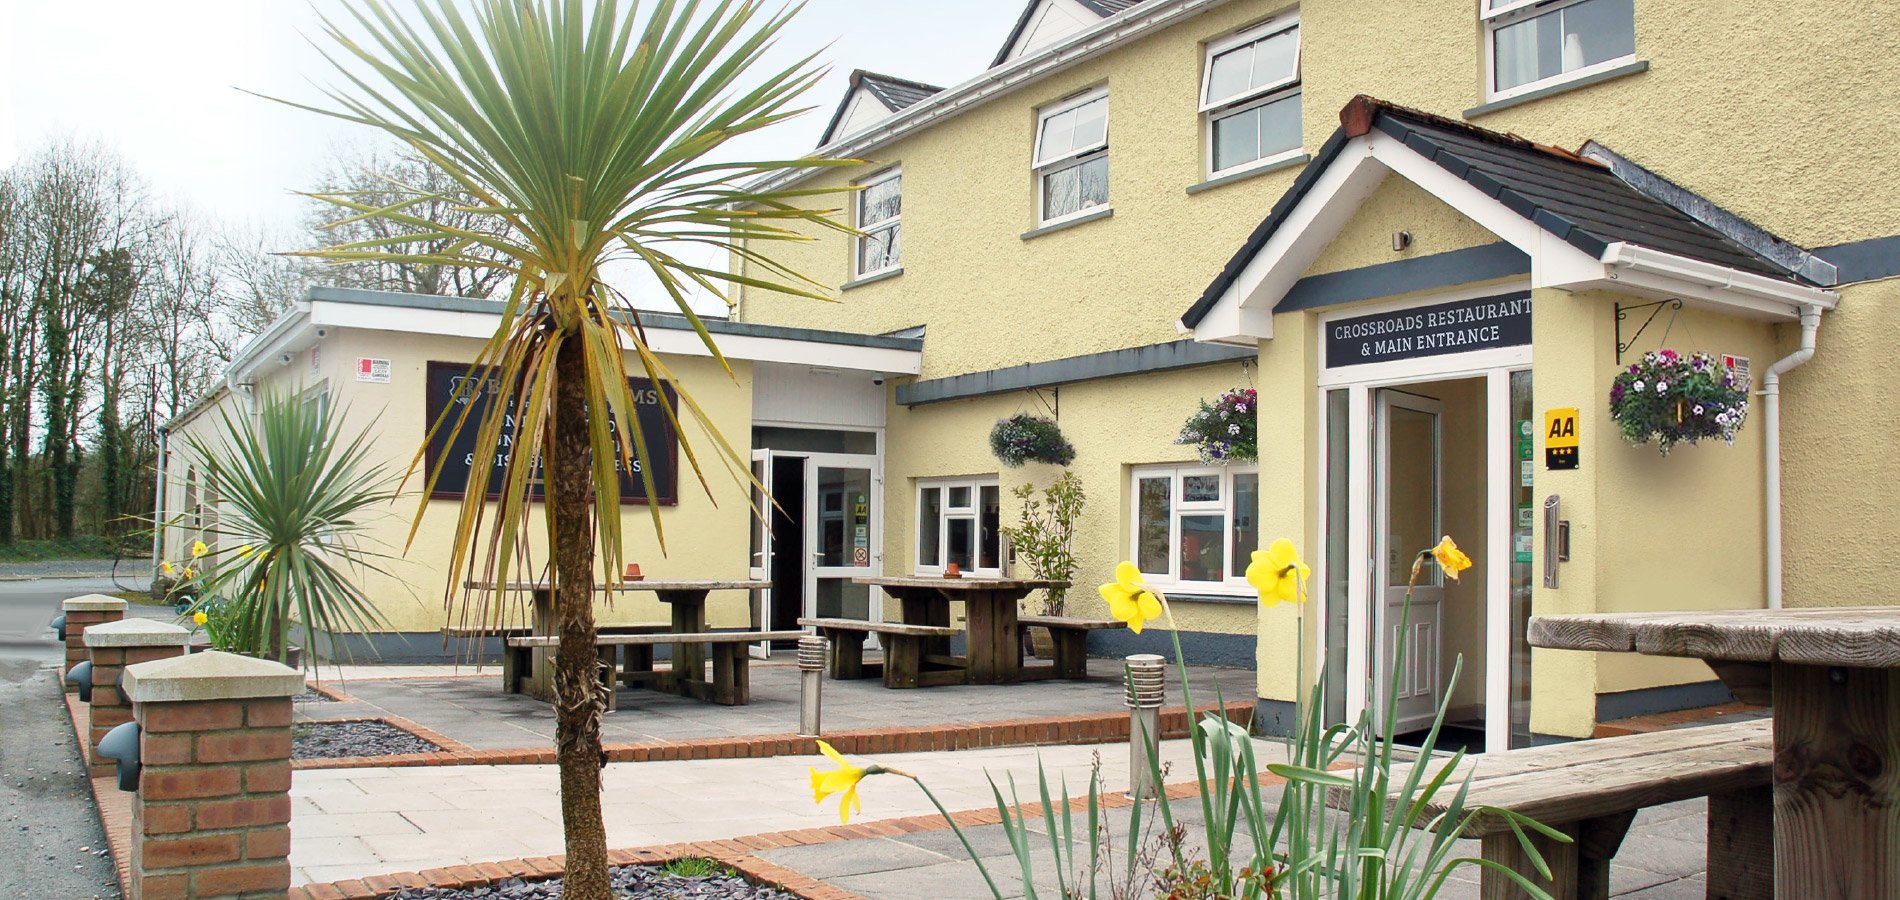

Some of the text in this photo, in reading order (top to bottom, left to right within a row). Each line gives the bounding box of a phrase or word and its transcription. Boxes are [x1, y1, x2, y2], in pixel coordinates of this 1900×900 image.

[1335, 298, 1532, 340] CROSSROADS RESTAURANT
[1361, 325, 1500, 356] & MAIN ENTRANCE
[1548, 416, 1574, 439] AA
[857, 506, 866, 514] AA
